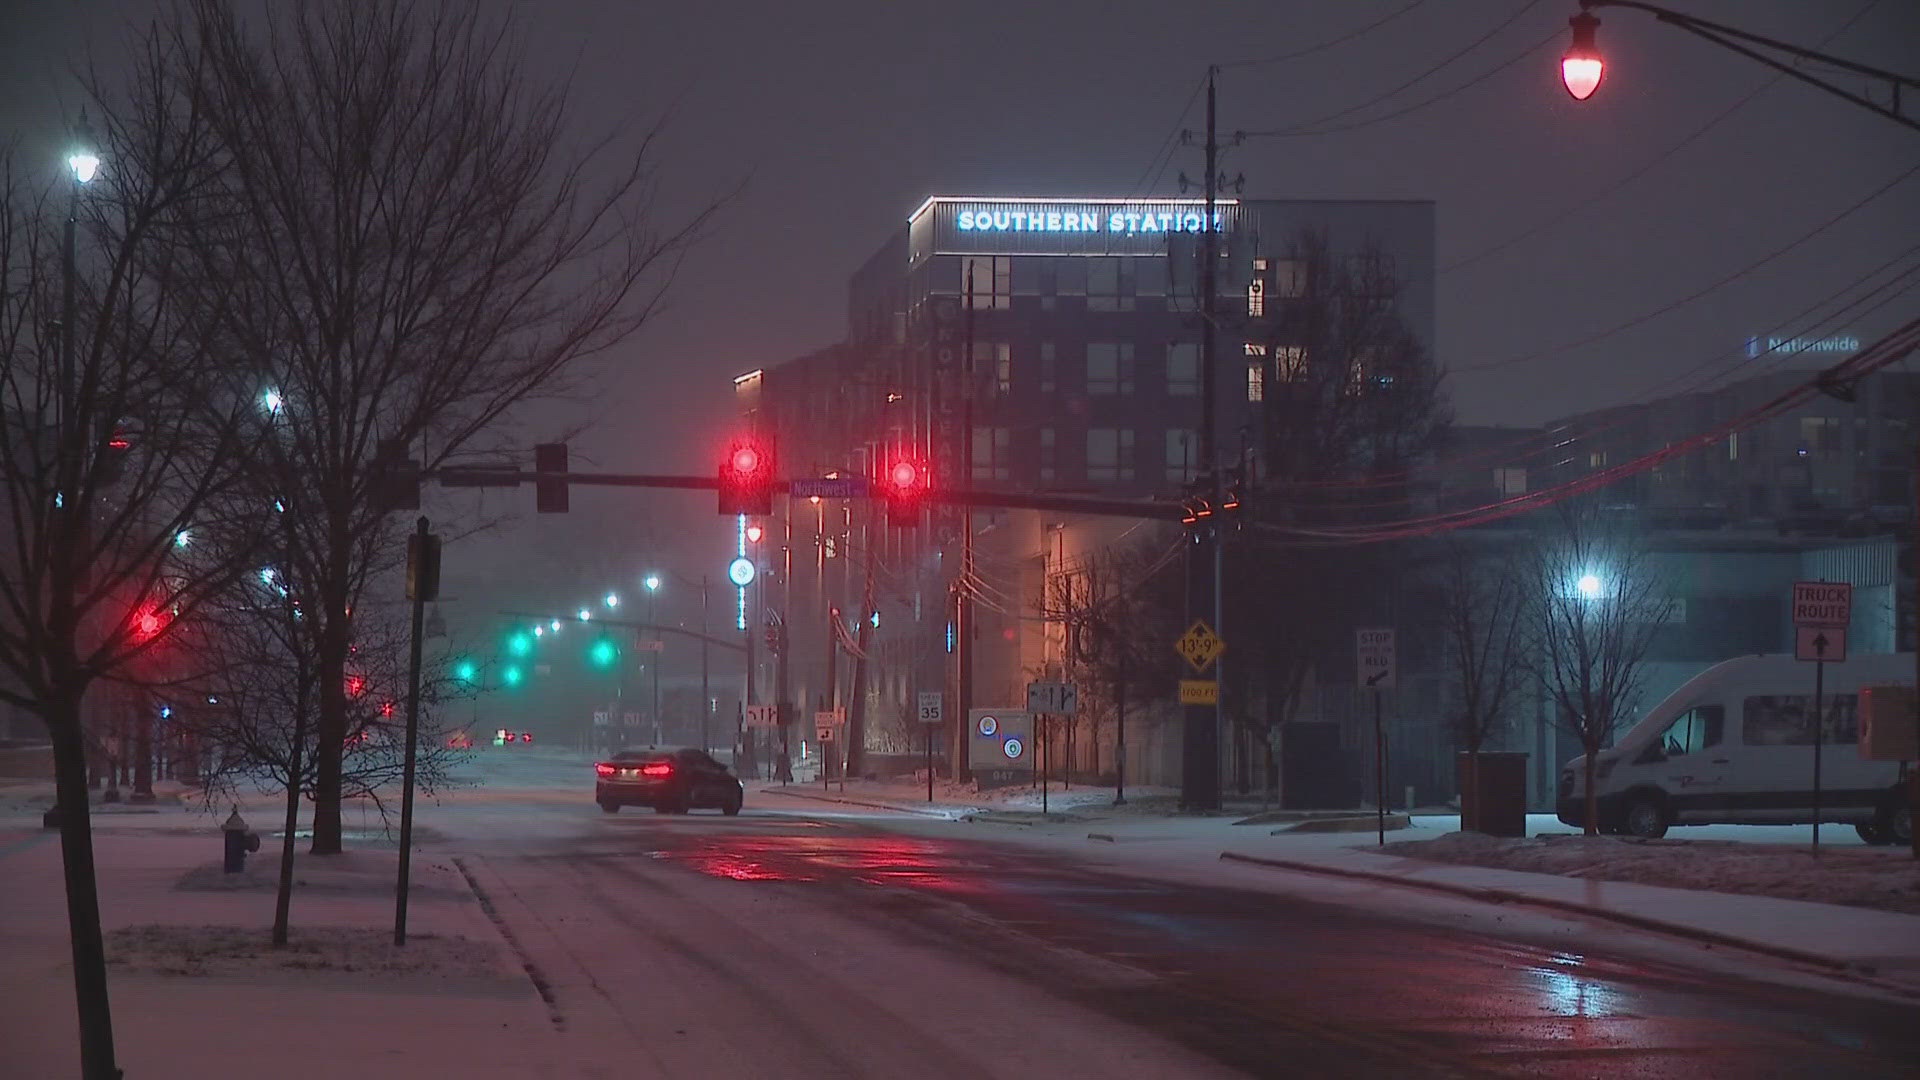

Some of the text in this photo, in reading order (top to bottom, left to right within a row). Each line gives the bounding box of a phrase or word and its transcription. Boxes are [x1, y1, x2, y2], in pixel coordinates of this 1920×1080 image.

[959, 212, 1099, 232] SOUTHERN
[1768, 336, 1860, 353] Nationwide
[794, 481, 851, 497] Northwest
[1797, 587, 1846, 602] TRUCK
[1797, 604, 1846, 619] ROUTE
[1361, 632, 1391, 644] STOP
[921, 707, 939, 719] 35
